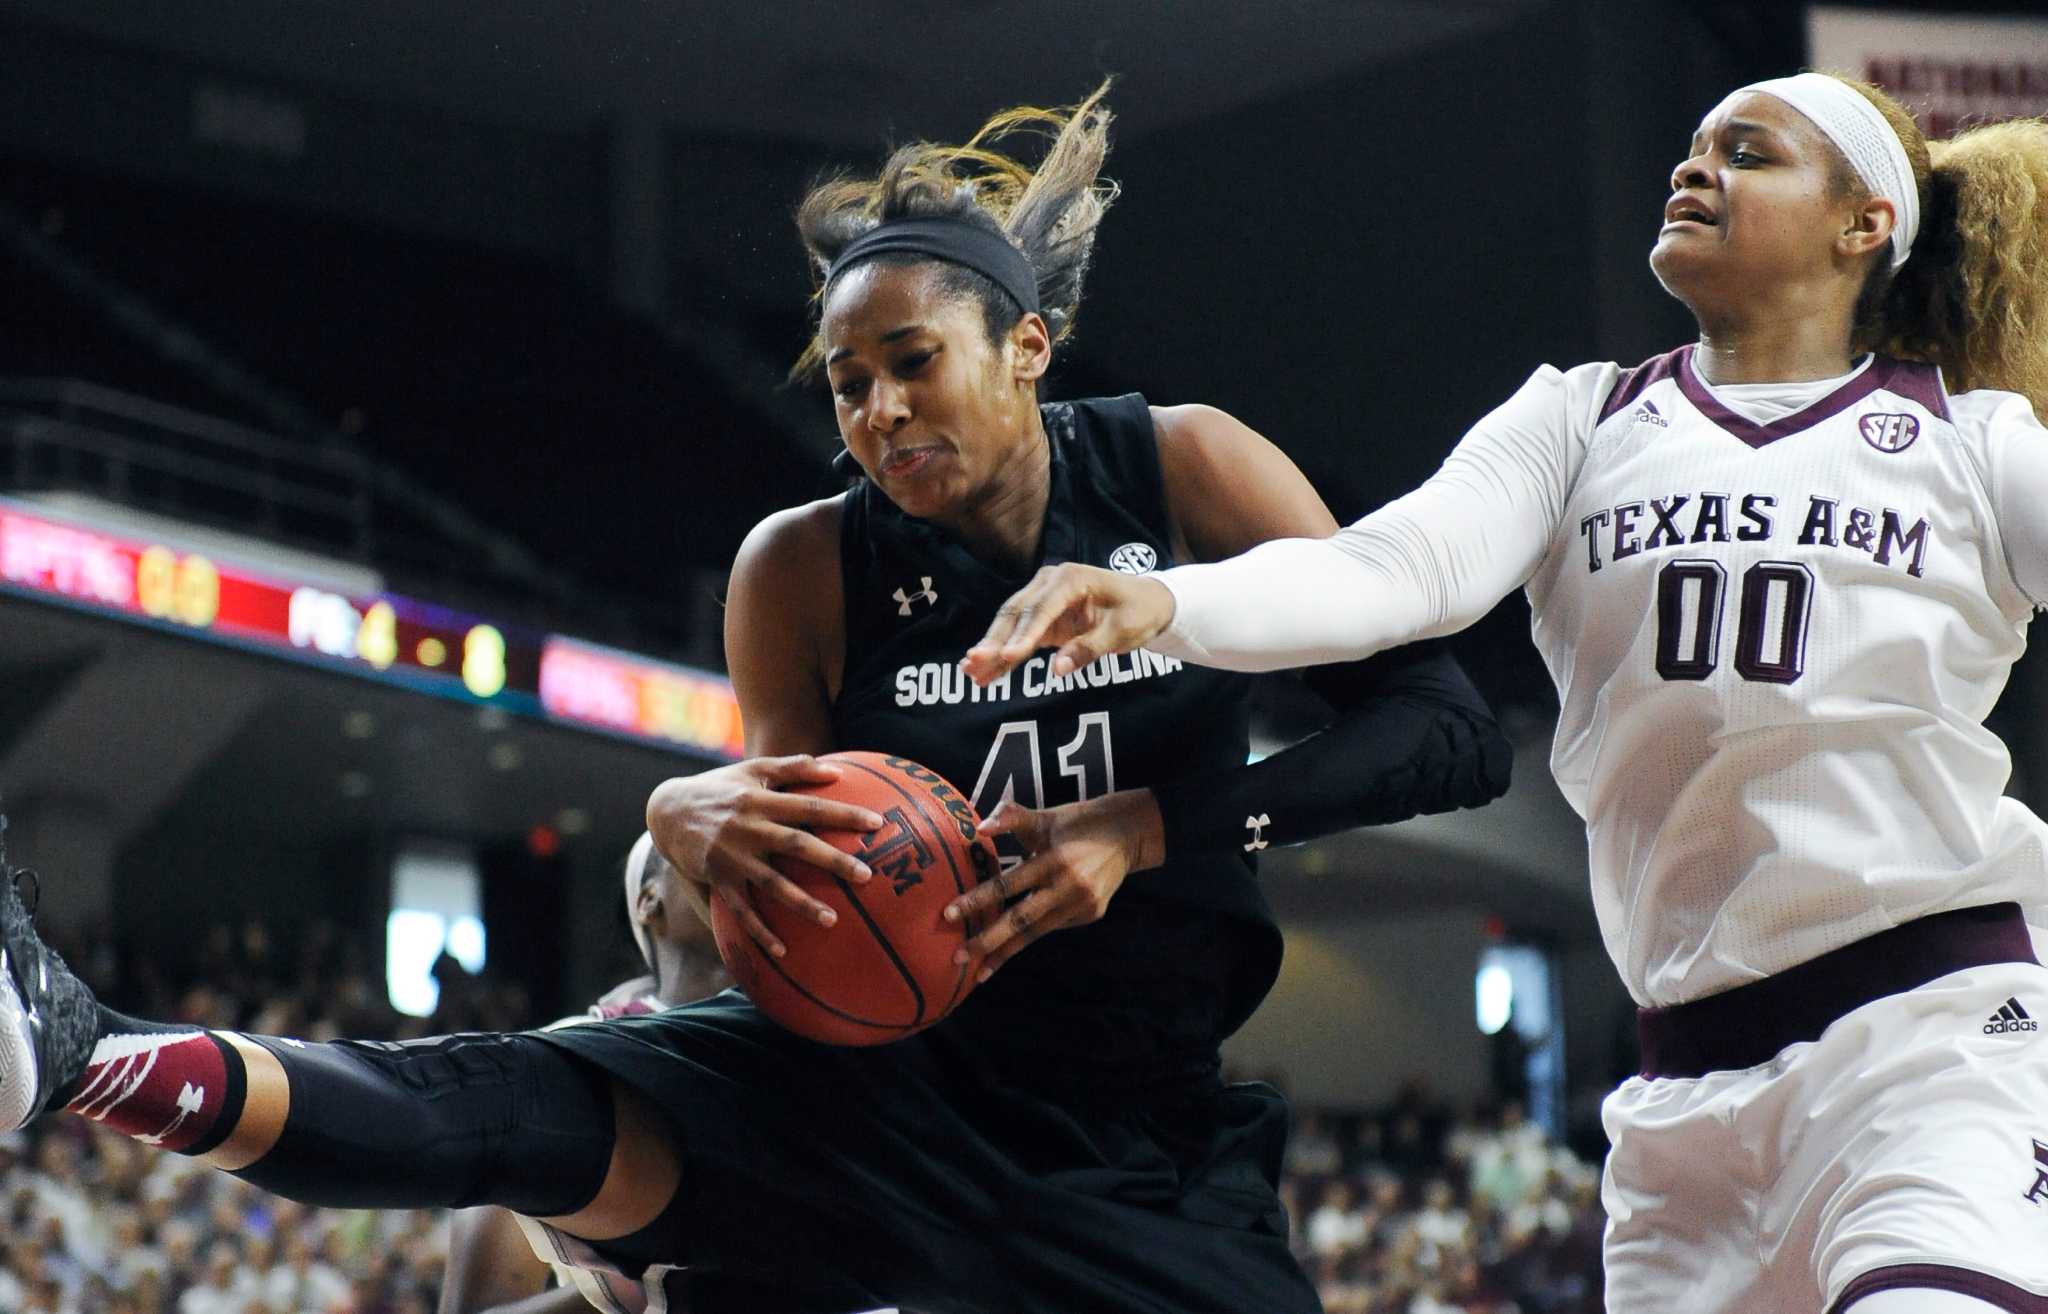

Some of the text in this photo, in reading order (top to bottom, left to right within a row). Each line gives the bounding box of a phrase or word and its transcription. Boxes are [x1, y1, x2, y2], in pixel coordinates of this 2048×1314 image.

[1863, 414, 1918, 451] SEC
[1110, 544, 1156, 576] SEC
[1581, 491, 1932, 578] TEXAS A&M
[1656, 559, 1815, 685] 00
[969, 711, 1115, 860] 41
[1983, 1020, 2038, 1034] adidas
